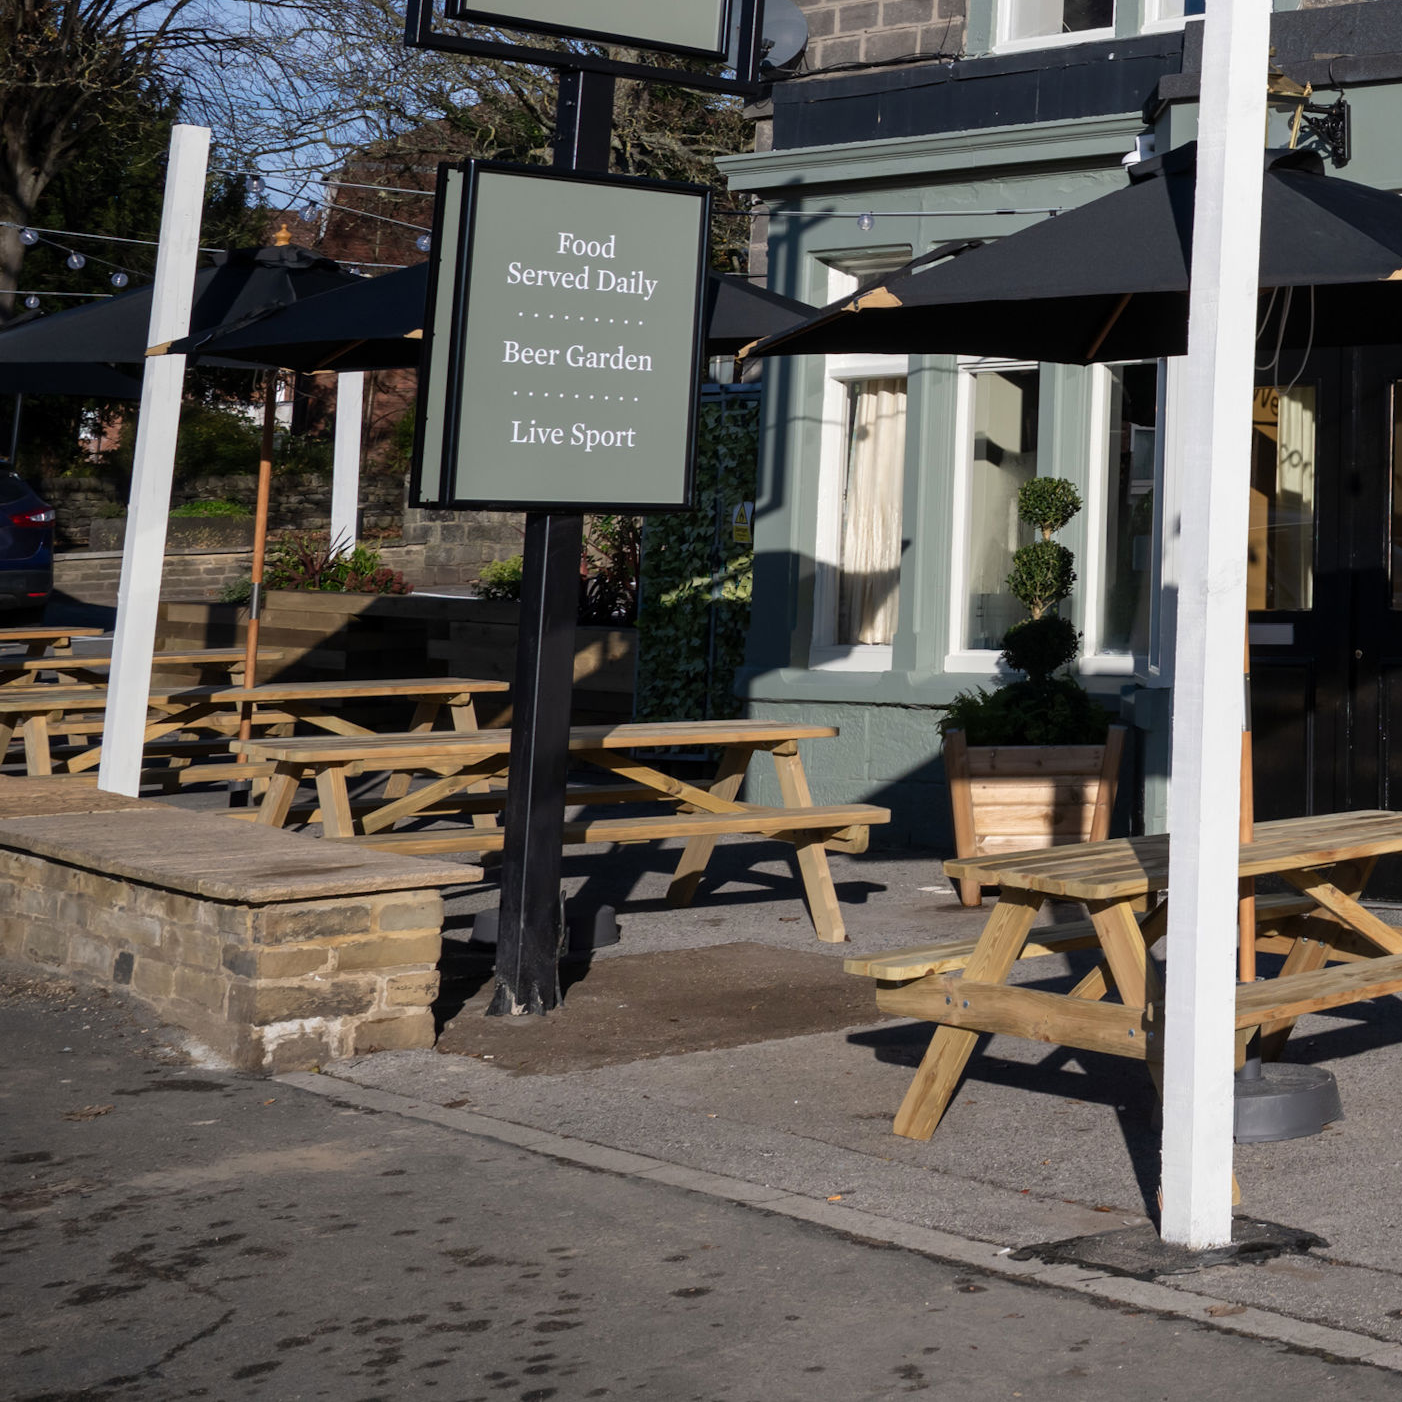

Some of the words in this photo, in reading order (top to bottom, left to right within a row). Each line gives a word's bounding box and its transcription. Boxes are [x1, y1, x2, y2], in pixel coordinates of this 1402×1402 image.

[556, 231, 617, 259] Food
[506, 261, 590, 291] Served
[595, 269, 659, 301] Daily
[502, 340, 561, 366] Beer
[565, 343, 654, 372] Garden
[510, 420, 564, 445] Live
[570, 422, 637, 453] Sport
